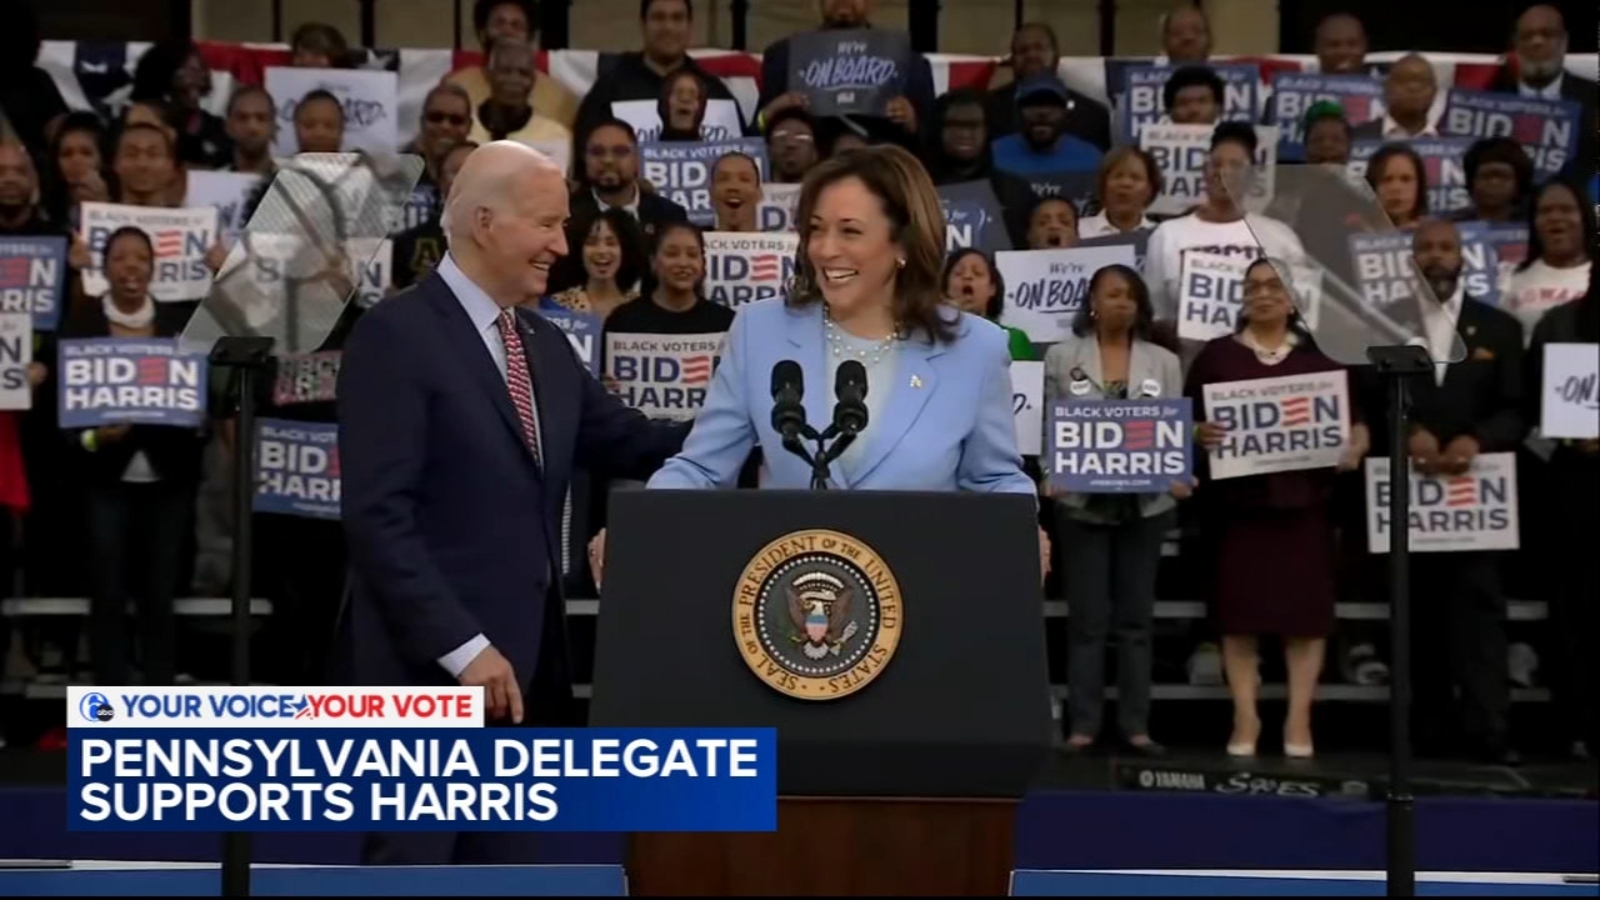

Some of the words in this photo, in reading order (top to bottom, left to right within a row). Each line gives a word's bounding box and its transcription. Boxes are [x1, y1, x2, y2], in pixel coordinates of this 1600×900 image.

[832, 56, 896, 86] BOARD
[644, 148, 687, 159] BLACK
[731, 239, 784, 250] VOTERS
[711, 254, 797, 281] IDEN
[1015, 278, 1045, 310] ON
[1045, 277, 1089, 307] BOA
[613, 341, 659, 351] BLACK
[663, 341, 716, 352] VOTERS
[65, 358, 199, 386] BIDEN
[65, 387, 199, 410] HARRIS
[1210, 387, 1257, 400] BLACK
[1260, 382, 1315, 398] VOTERS
[1055, 406, 1100, 418] BLACK
[1104, 406, 1160, 418] VOTERS
[1161, 406, 1179, 418] for
[1213, 394, 1341, 432] BIDEN
[261, 425, 304, 441] BLACK
[308, 430, 337, 443] VOT
[1055, 420, 1184, 450] BIDEN
[1215, 426, 1343, 460] HARRIS
[260, 440, 341, 475] BID
[1055, 452, 1186, 476] HARRIS
[1375, 477, 1507, 508] BDEN
[821, 538, 838, 549] OF
[840, 542, 860, 558] THE
[740, 535, 818, 607] PRESIDENT
[864, 558, 897, 630] UNITED
[740, 613, 752, 636] THE
[745, 640, 759, 655] OF
[757, 655, 799, 690] SEAL
[828, 643, 888, 693] STATES
